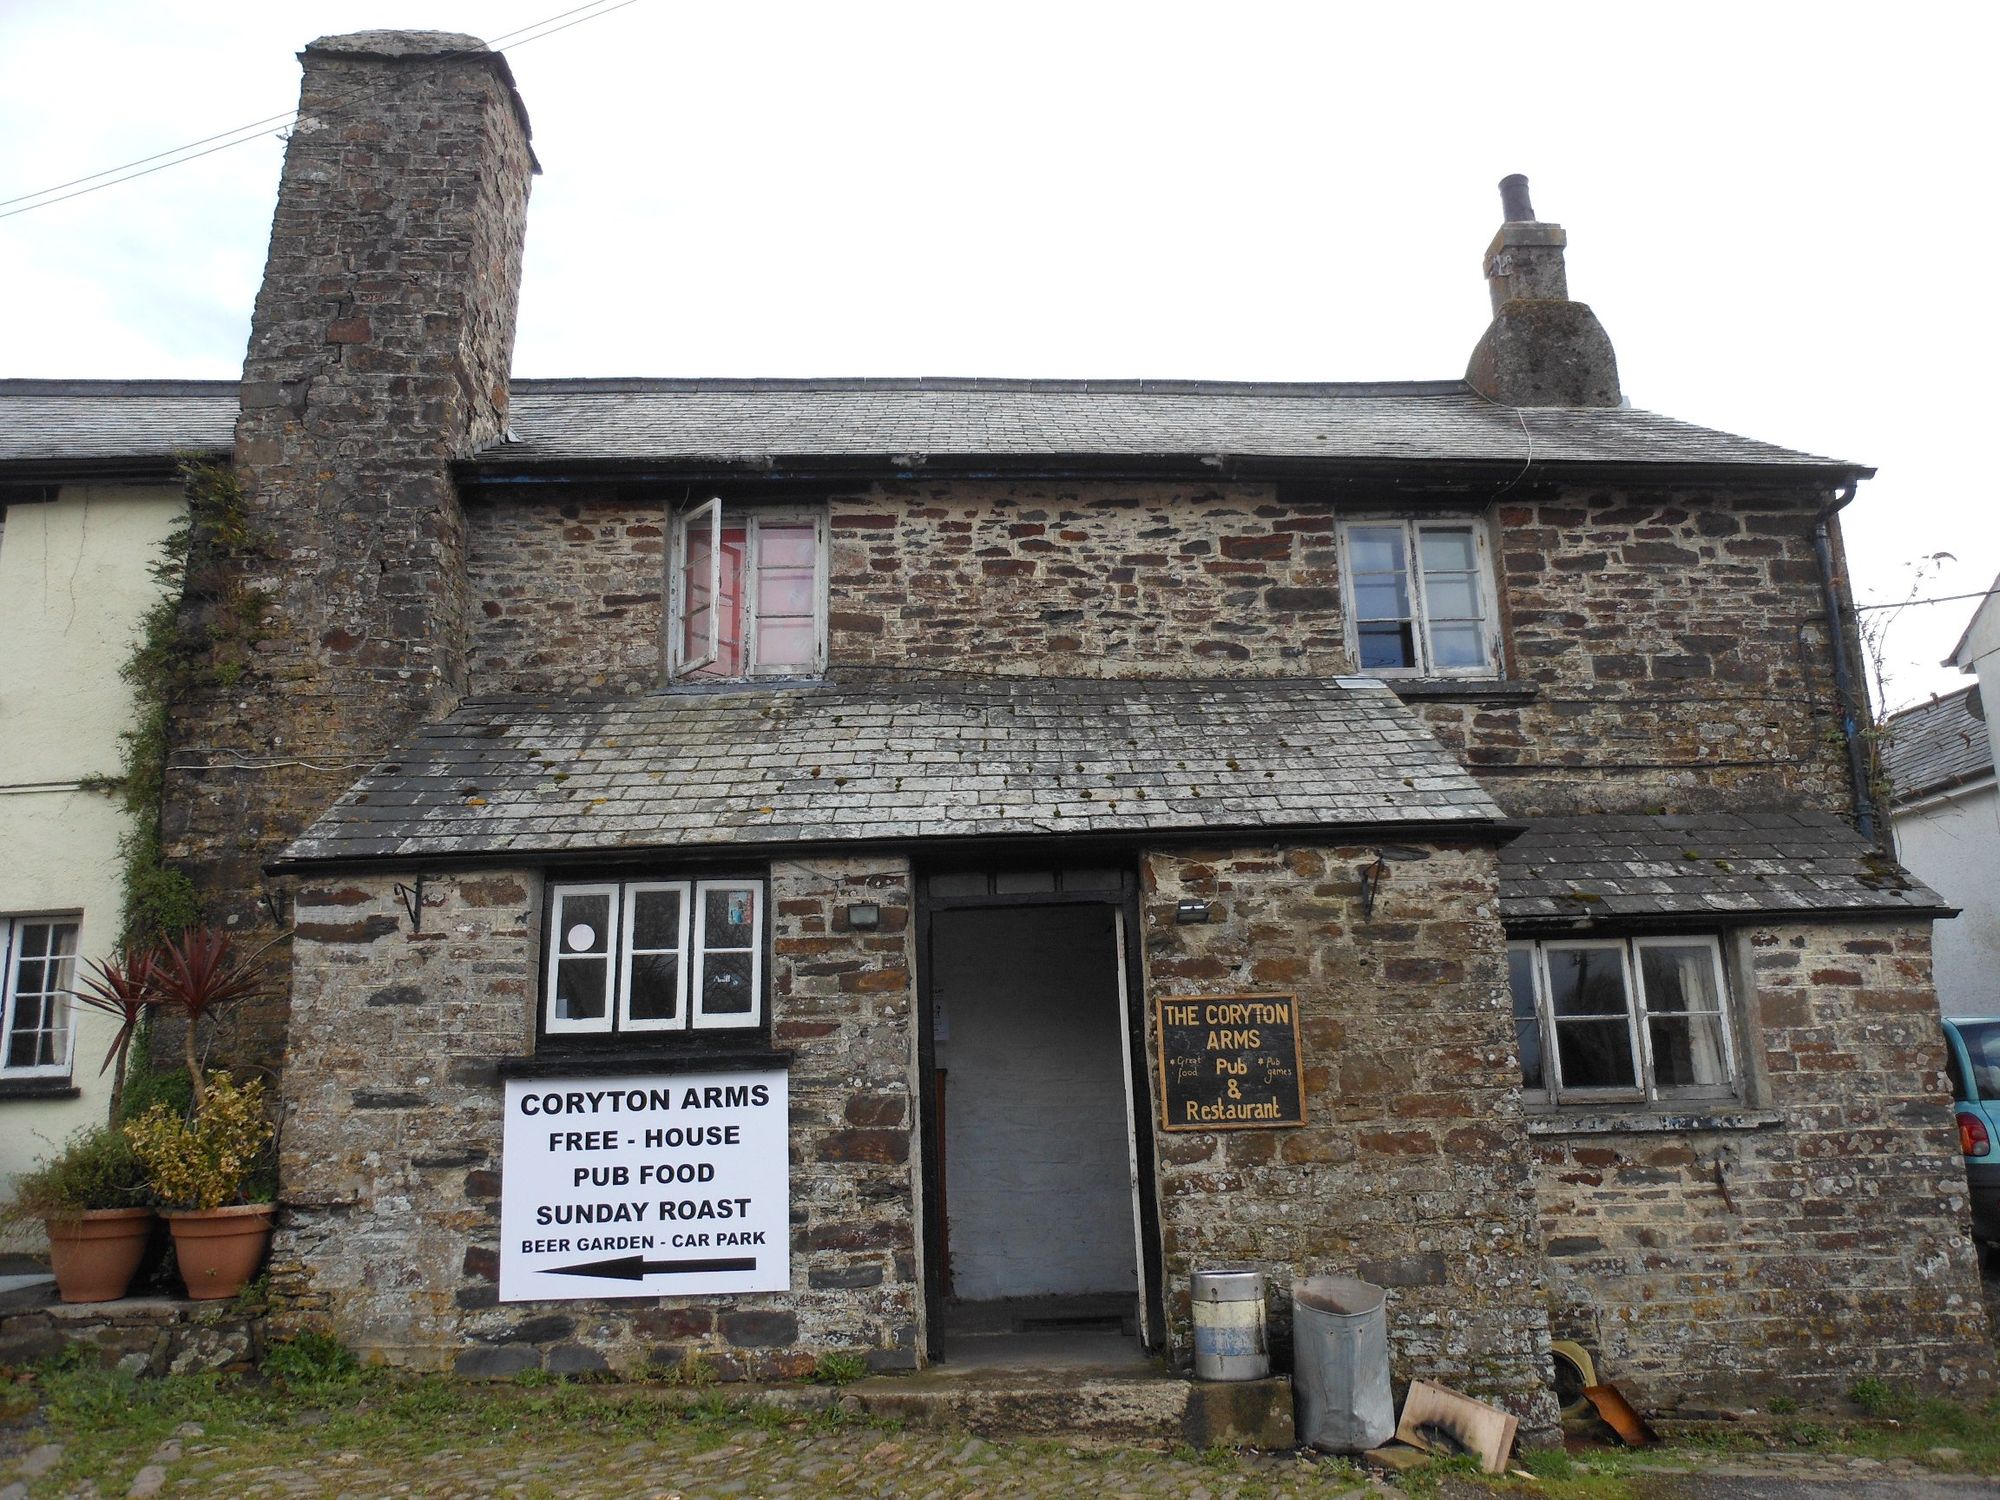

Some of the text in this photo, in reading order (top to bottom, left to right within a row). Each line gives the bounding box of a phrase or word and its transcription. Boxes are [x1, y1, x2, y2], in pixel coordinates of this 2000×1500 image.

[1164, 1003, 1290, 1026] THE CORYTON
[1206, 1029, 1261, 1050] ARMS
[1177, 1067, 1199, 1084] food
[1216, 1057, 1248, 1075] Pub
[1264, 1068, 1292, 1084] games
[520, 1084, 770, 1116] CORYTON ARMS
[1227, 1078, 1242, 1099] &
[1186, 1096, 1282, 1121] Restaurant
[549, 1130, 619, 1152] FREE
[645, 1125, 741, 1149] HOUSE
[573, 1162, 715, 1188] PUB FOOD
[536, 1198, 752, 1226] SUNDAY ROAST
[521, 1238, 571, 1254] BEER
[576, 1235, 655, 1252] GARDEN
[671, 1233, 711, 1248] CAR
[716, 1231, 767, 1247] PARK
